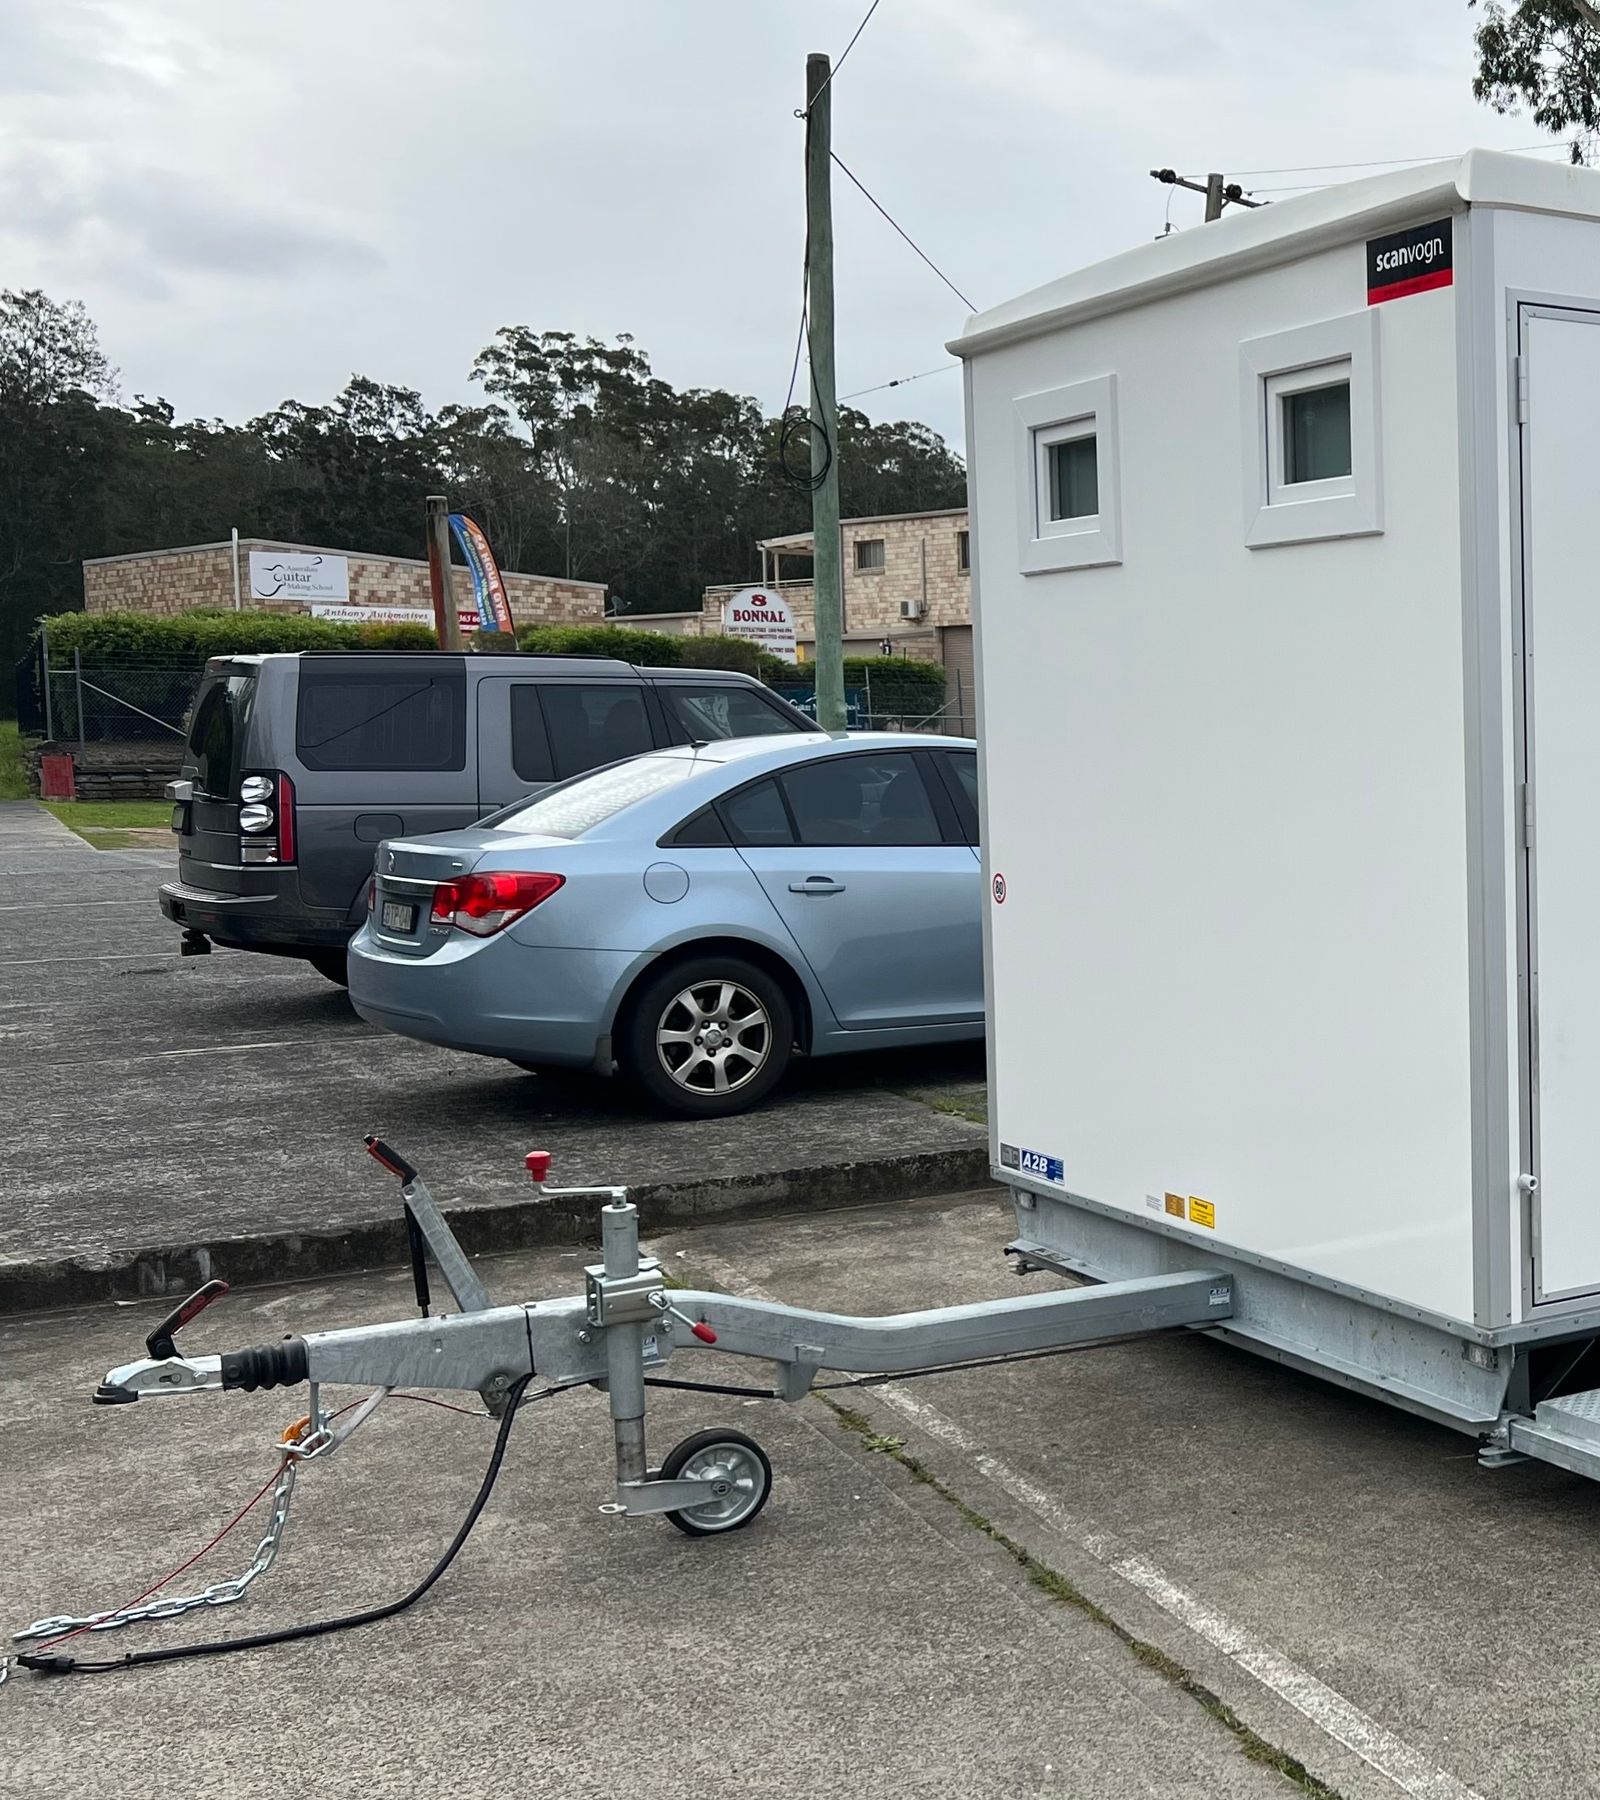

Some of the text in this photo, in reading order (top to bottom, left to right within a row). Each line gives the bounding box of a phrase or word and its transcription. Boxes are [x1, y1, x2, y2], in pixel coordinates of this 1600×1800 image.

[1376, 237, 1444, 272] scanvogn
[287, 583, 311, 591] Making
[481, 553, 499, 592] HOUR
[493, 593, 507, 622] GYM
[322, 608, 429, 620] Anthony Automotives
[732, 609, 786, 623] BONNAL
[1022, 1152, 1048, 1173] A2B
